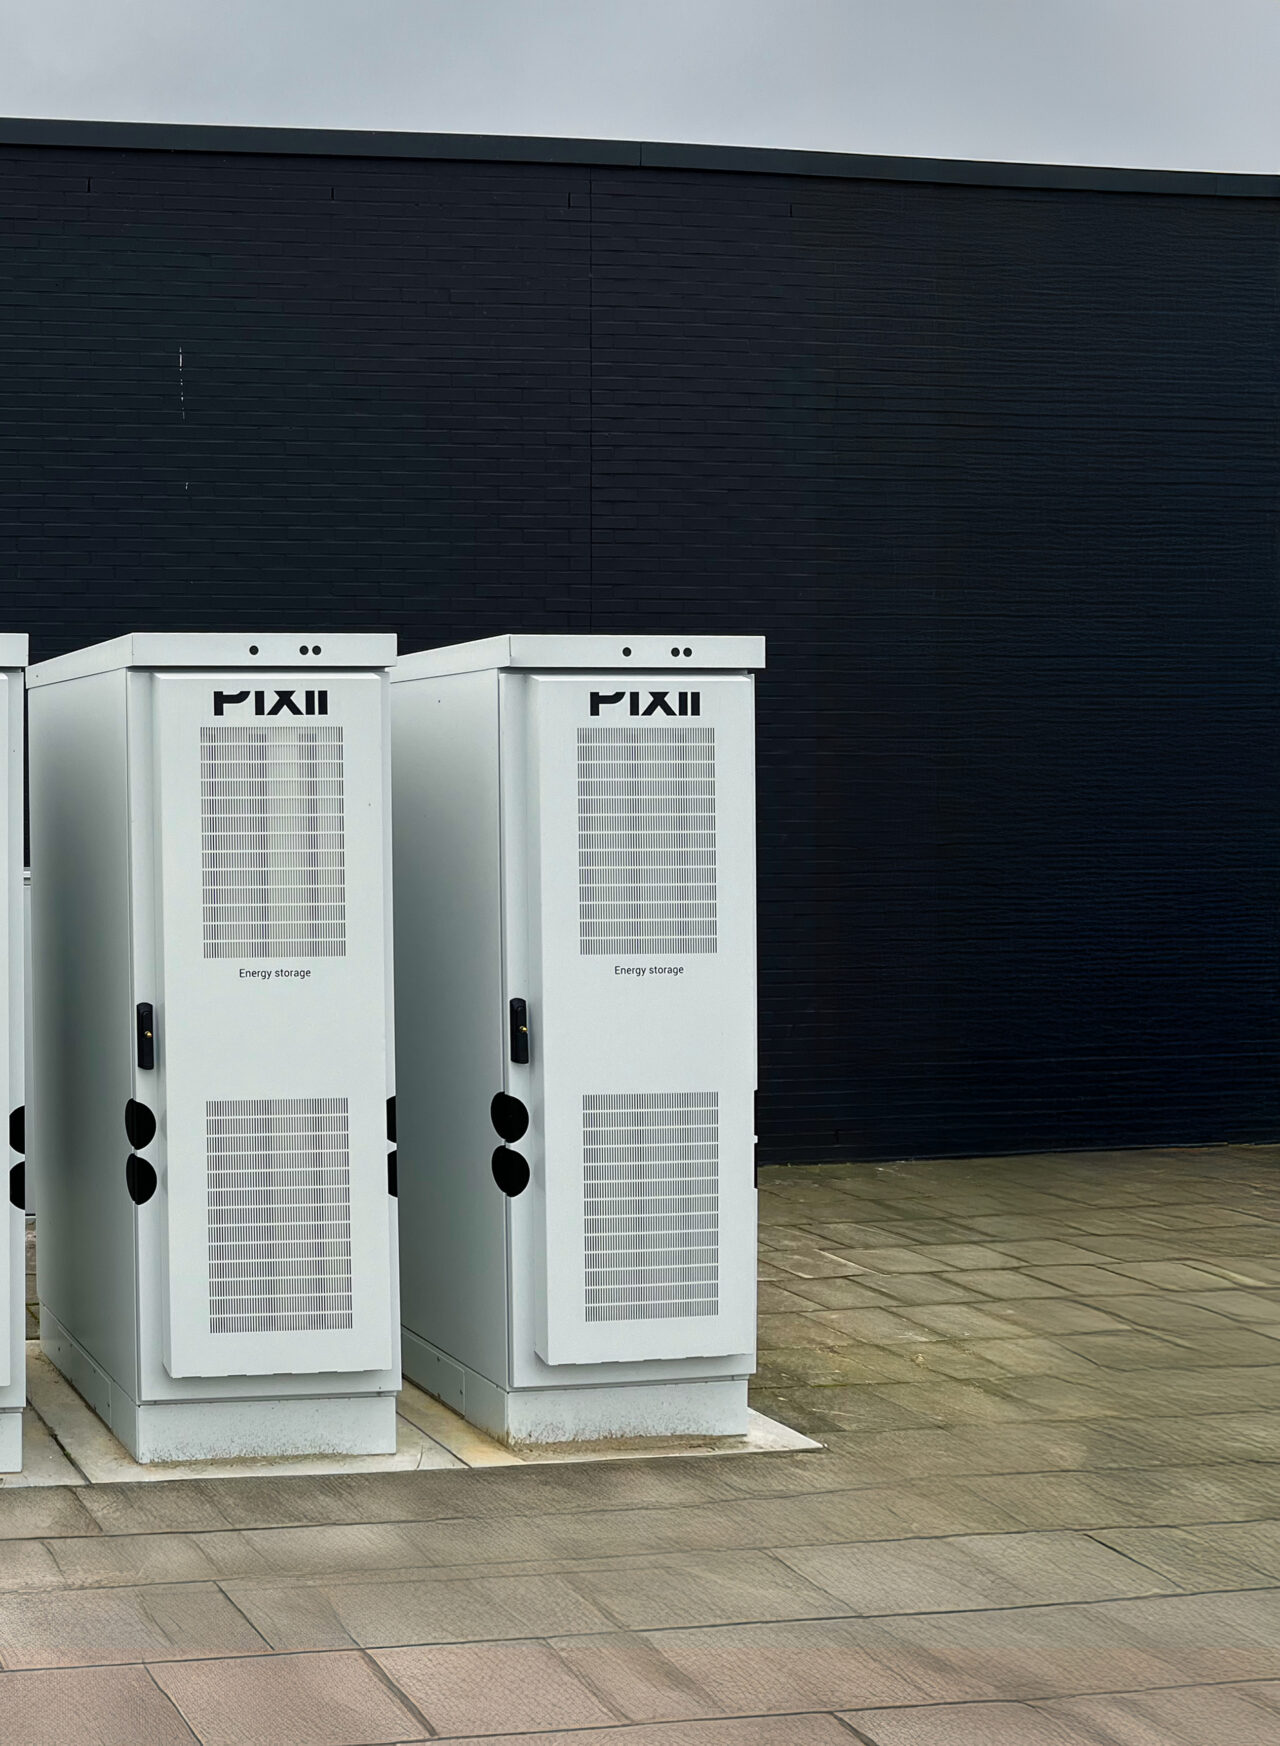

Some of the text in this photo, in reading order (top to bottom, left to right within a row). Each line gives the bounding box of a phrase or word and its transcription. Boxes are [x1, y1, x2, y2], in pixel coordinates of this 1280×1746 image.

[239, 968, 312, 980] Energy storage
[614, 965, 685, 977] Energy storage
